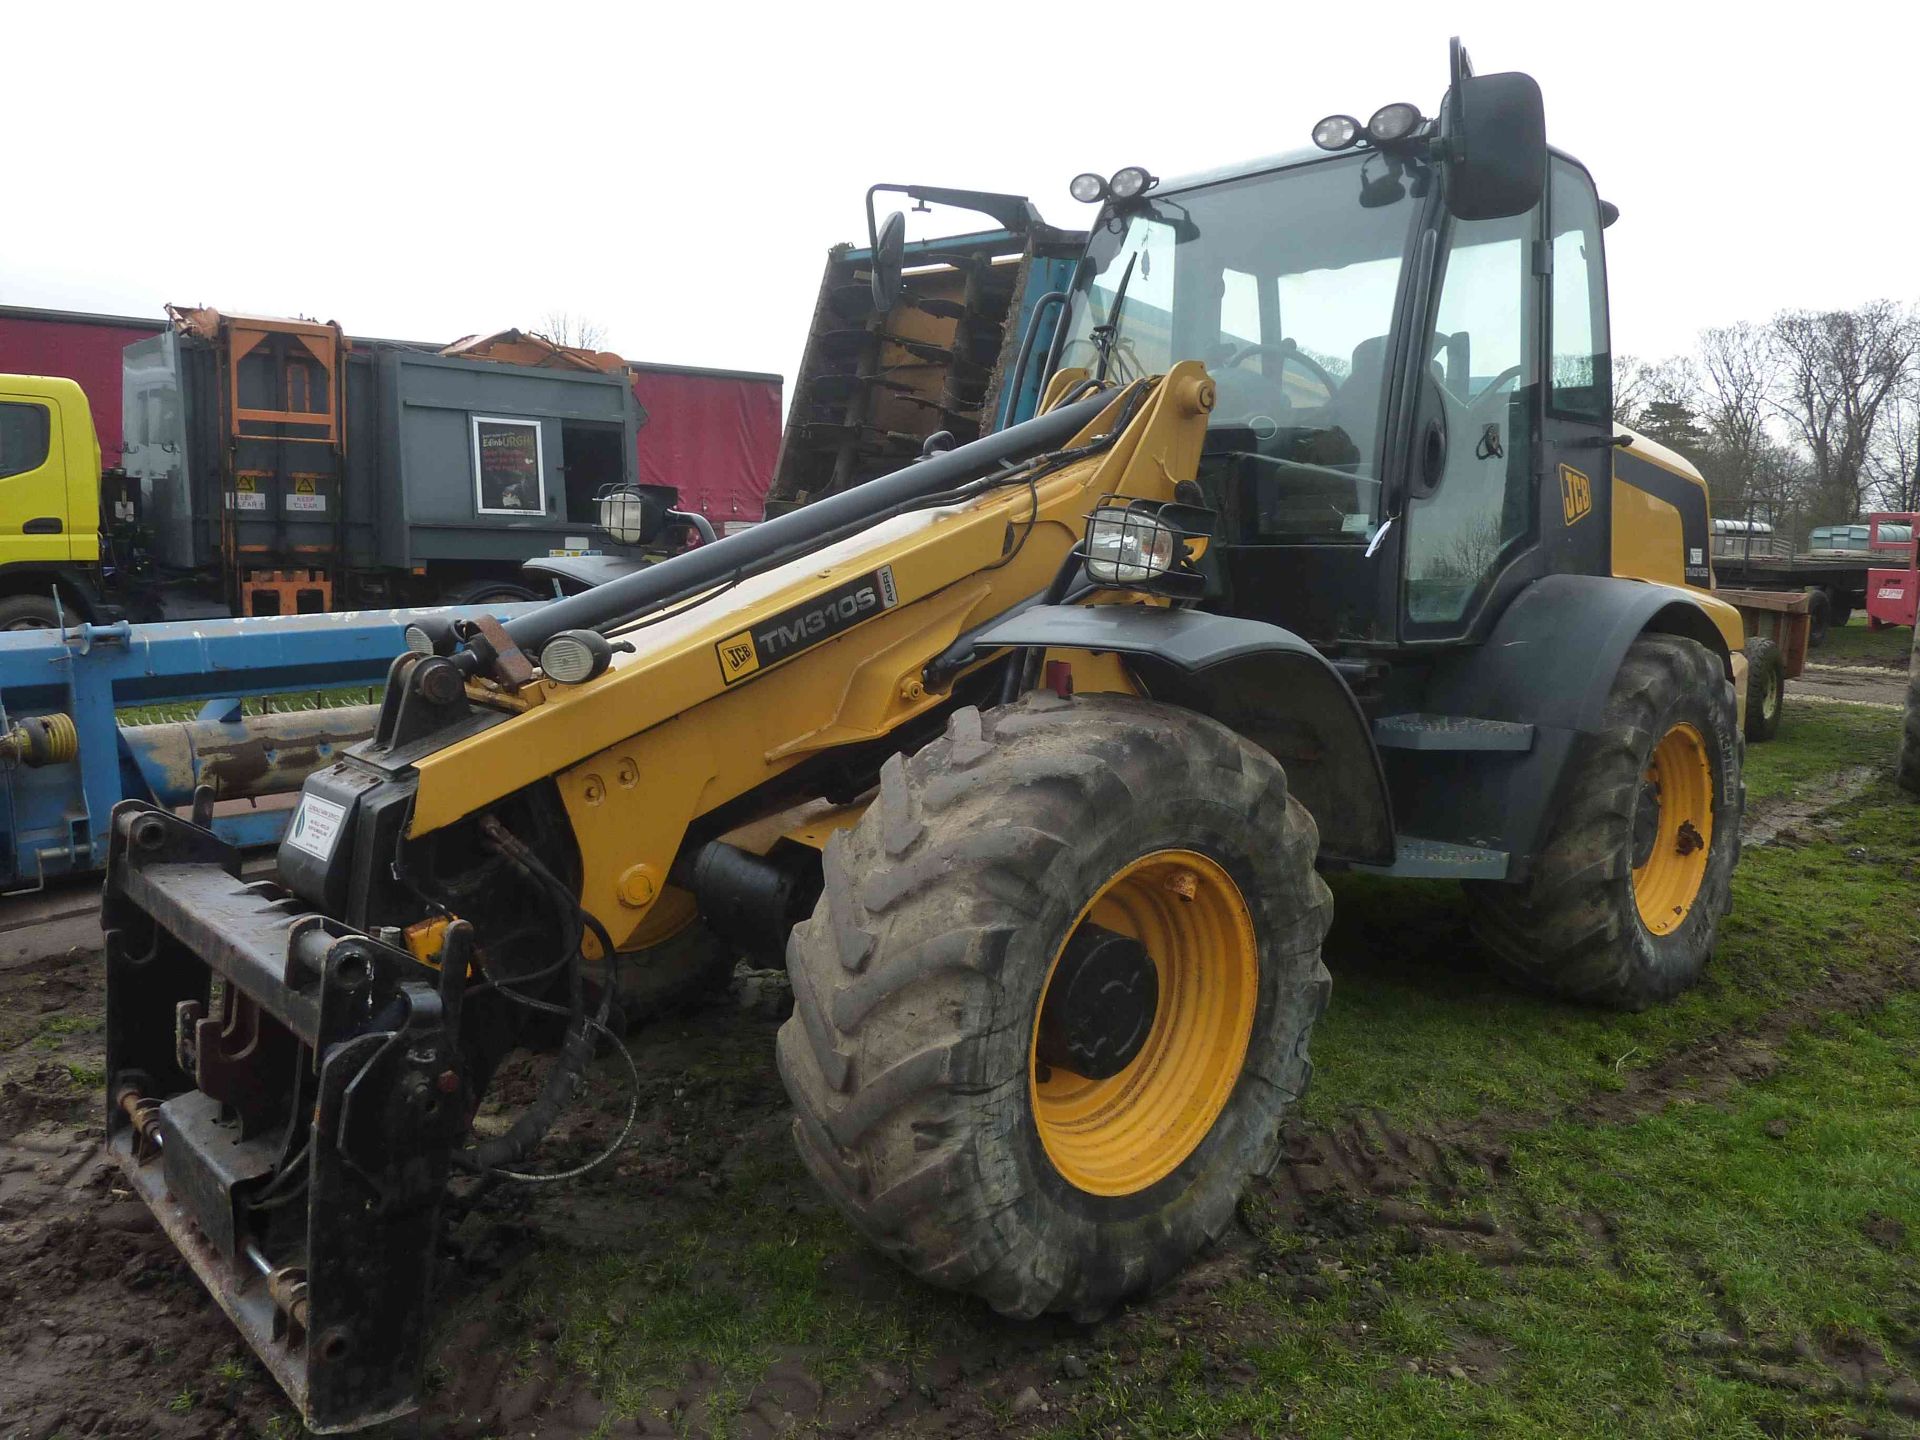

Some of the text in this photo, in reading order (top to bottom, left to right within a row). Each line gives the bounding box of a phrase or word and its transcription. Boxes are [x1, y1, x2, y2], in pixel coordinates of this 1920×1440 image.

[296, 495, 315, 503] KEEP
[1564, 470, 1590, 519] JCB
[882, 571, 895, 602] AGRI
[759, 586, 876, 654] TM310S
[727, 644, 752, 668] JCB
